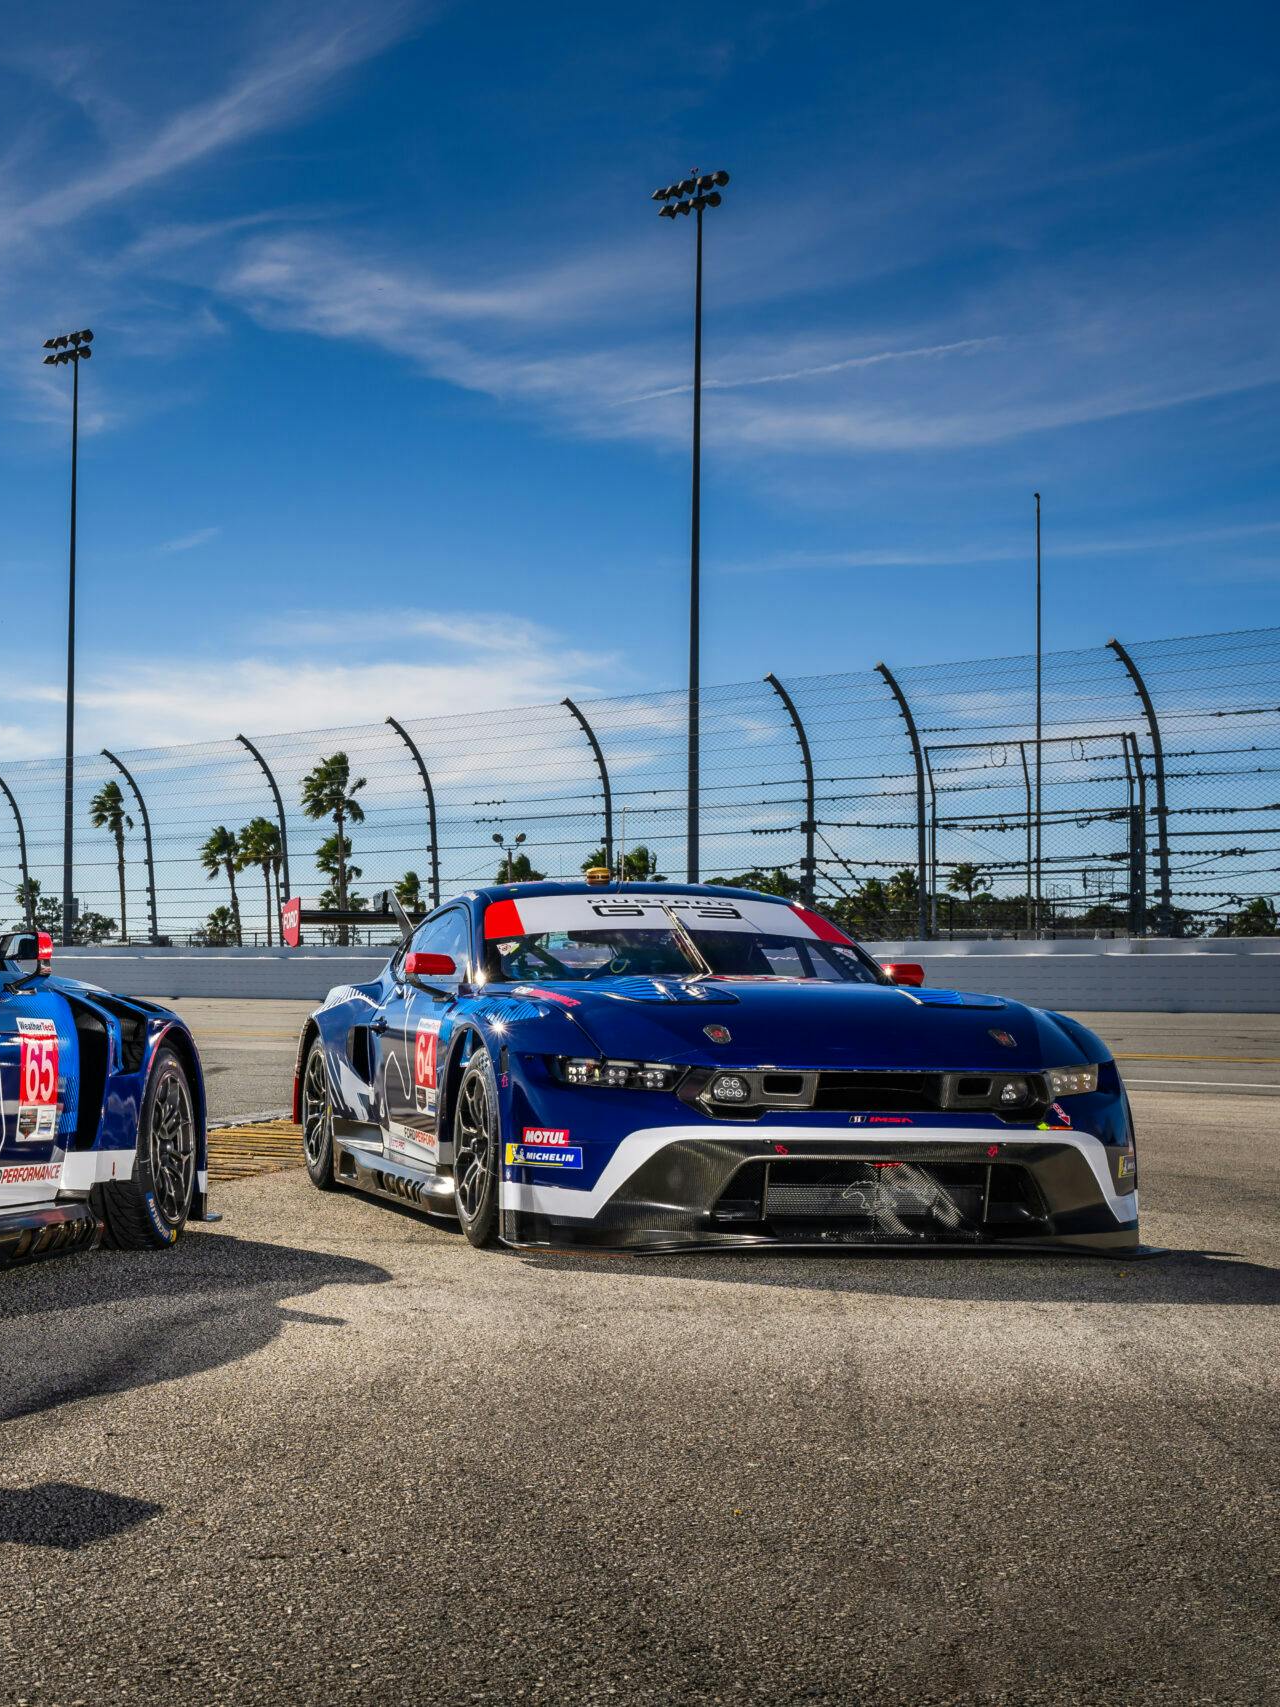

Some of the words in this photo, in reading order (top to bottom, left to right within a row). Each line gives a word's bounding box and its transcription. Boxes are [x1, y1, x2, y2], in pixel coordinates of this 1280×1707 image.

[587, 899, 734, 907] MUSTANG
[282, 910, 298, 929] FORD
[592, 904, 742, 920] GT3
[417, 1034, 433, 1085] 64
[25, 1039, 54, 1102] 65
[525, 1130, 566, 1145] MOTUL
[525, 1152, 574, 1162] MICHELIN
